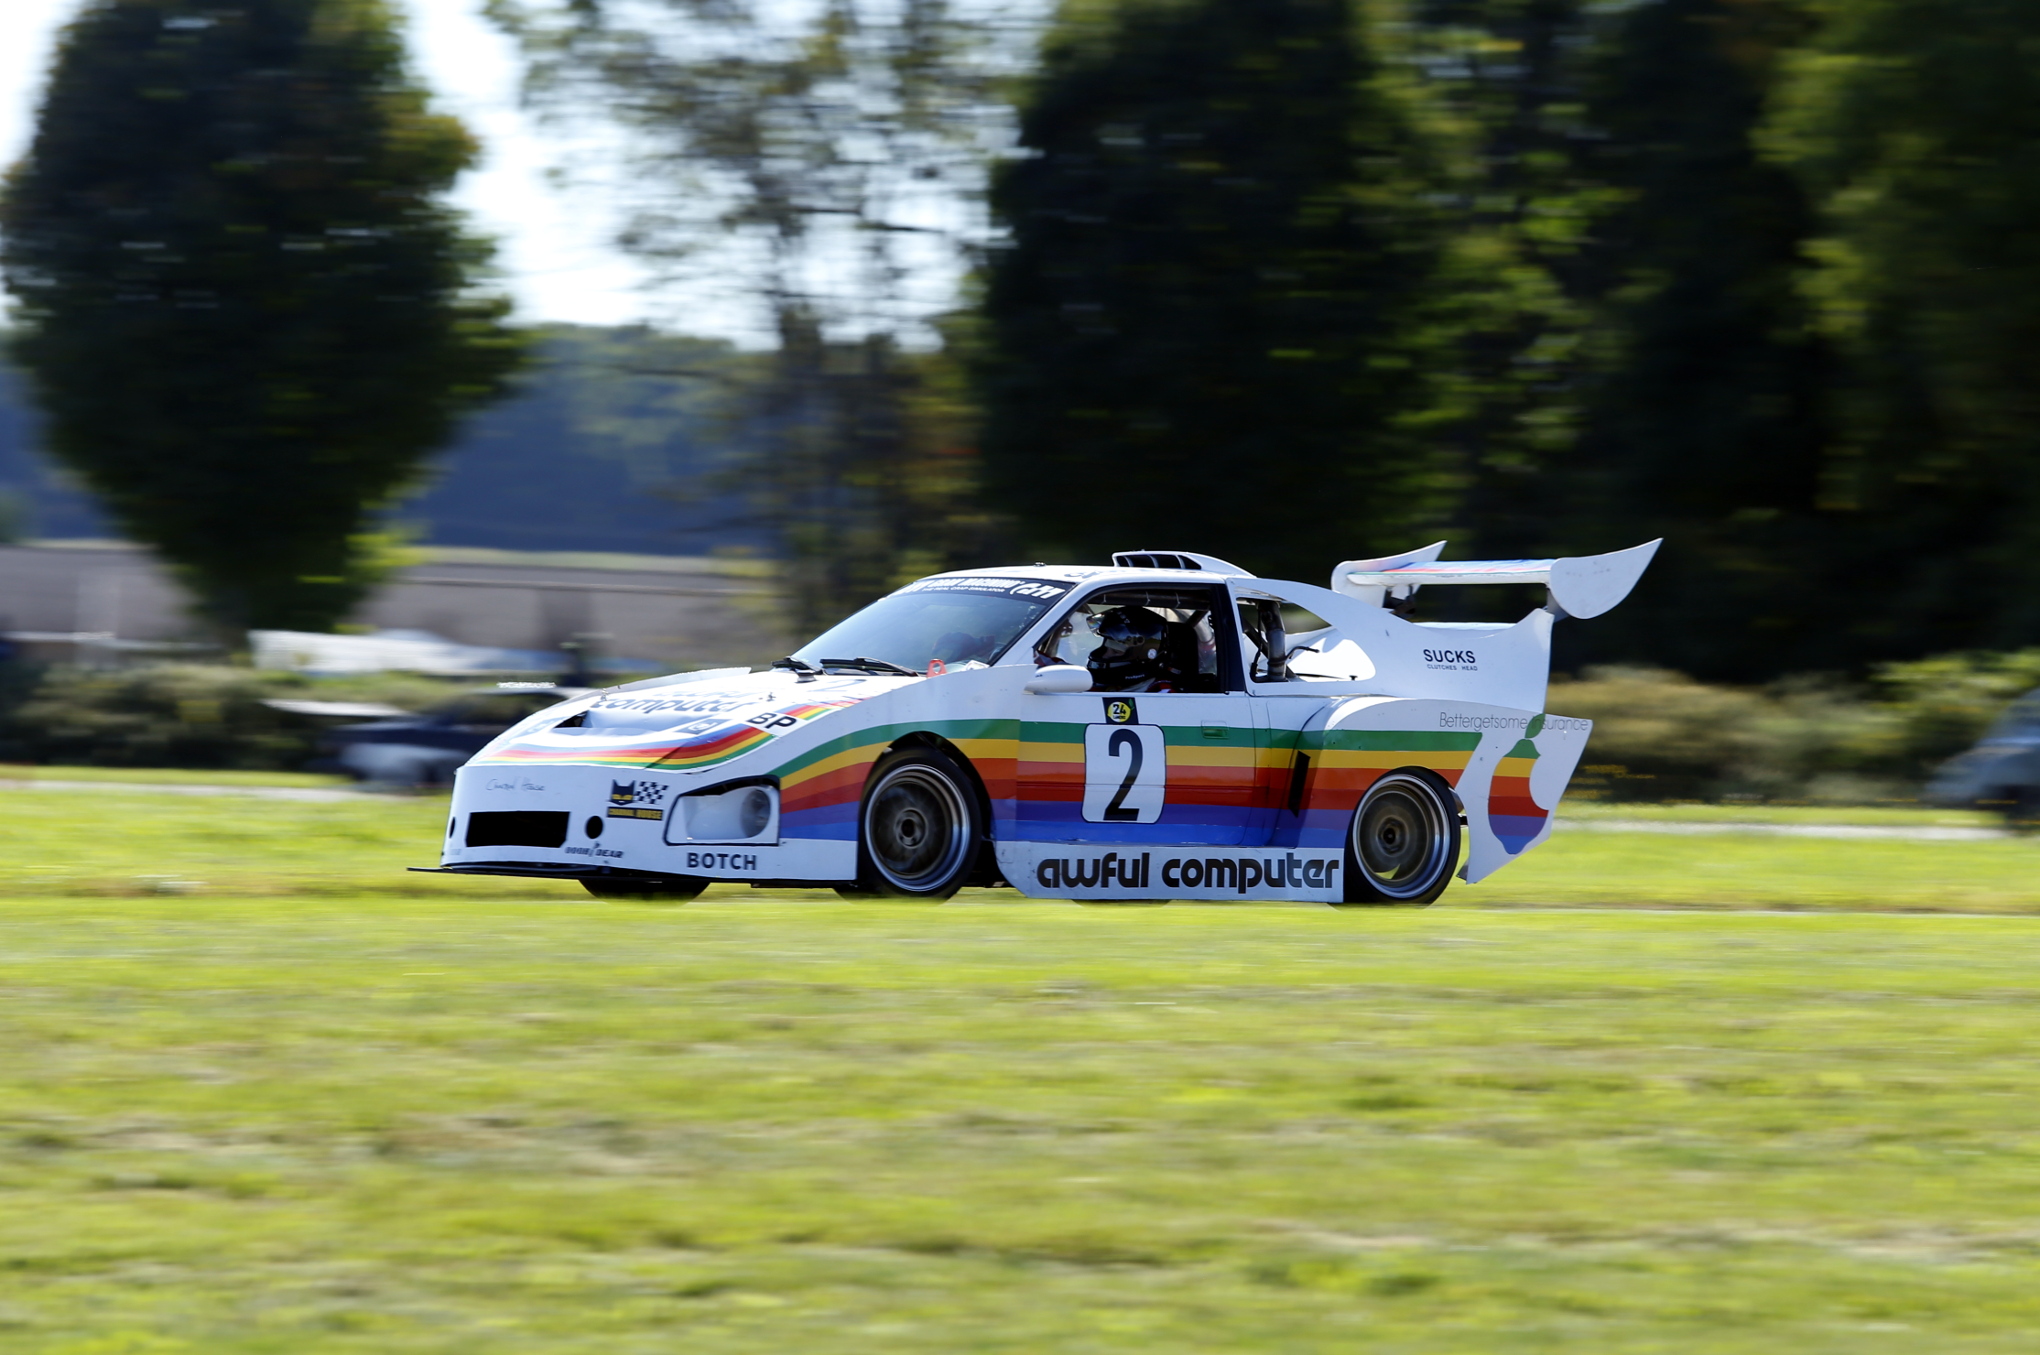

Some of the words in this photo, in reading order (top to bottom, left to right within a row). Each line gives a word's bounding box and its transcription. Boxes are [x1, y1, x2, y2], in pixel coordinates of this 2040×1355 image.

[1423, 648, 1476, 664] SUCKS
[1426, 663, 1457, 671] CLUTCHES
[1112, 703, 1127, 715] 24
[745, 712, 797, 729] BP
[1103, 728, 1144, 821] 2
[686, 852, 757, 871] BOTCH
[1036, 851, 1151, 889] awful
[1161, 851, 1340, 895] computer
